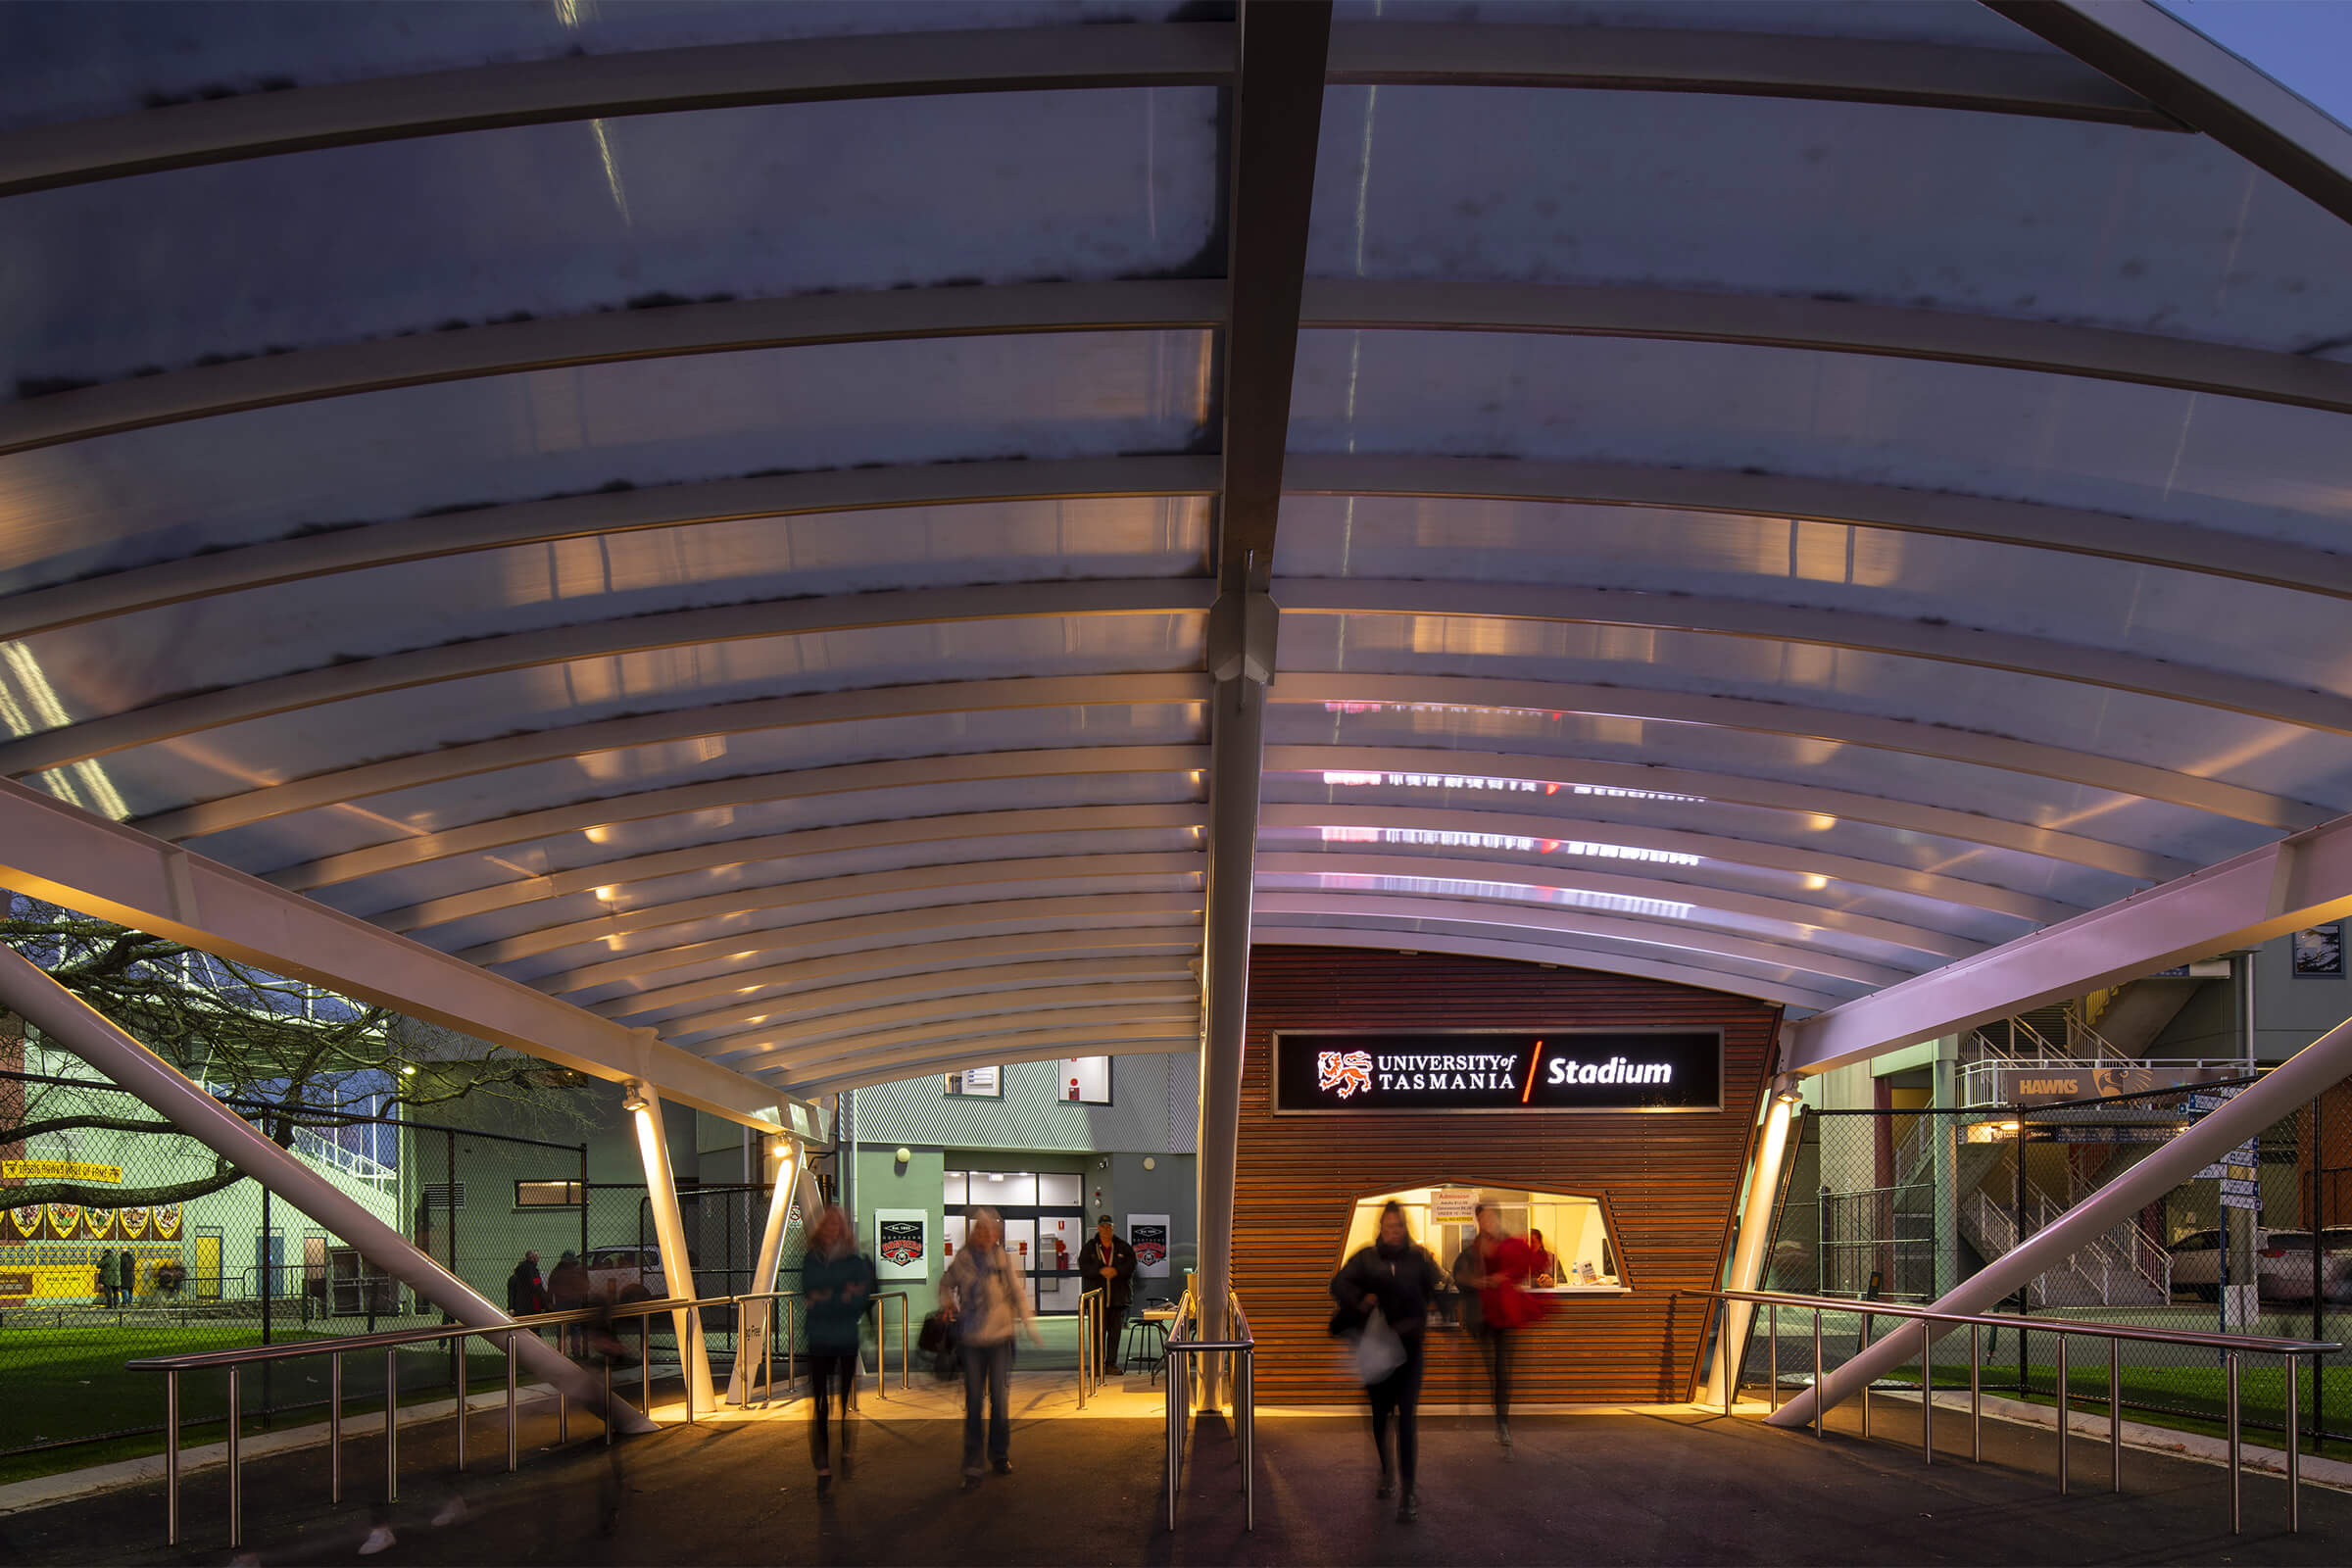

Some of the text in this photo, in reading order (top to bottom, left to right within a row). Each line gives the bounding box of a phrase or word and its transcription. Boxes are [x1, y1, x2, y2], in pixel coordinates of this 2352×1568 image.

[1378, 1054, 1518, 1074] UNIVERSITY of
[1547, 1057, 1672, 1085] Stadium
[1379, 1073, 1516, 1091] TASMANIA
[2020, 1079, 2078, 1095] HAWKS
